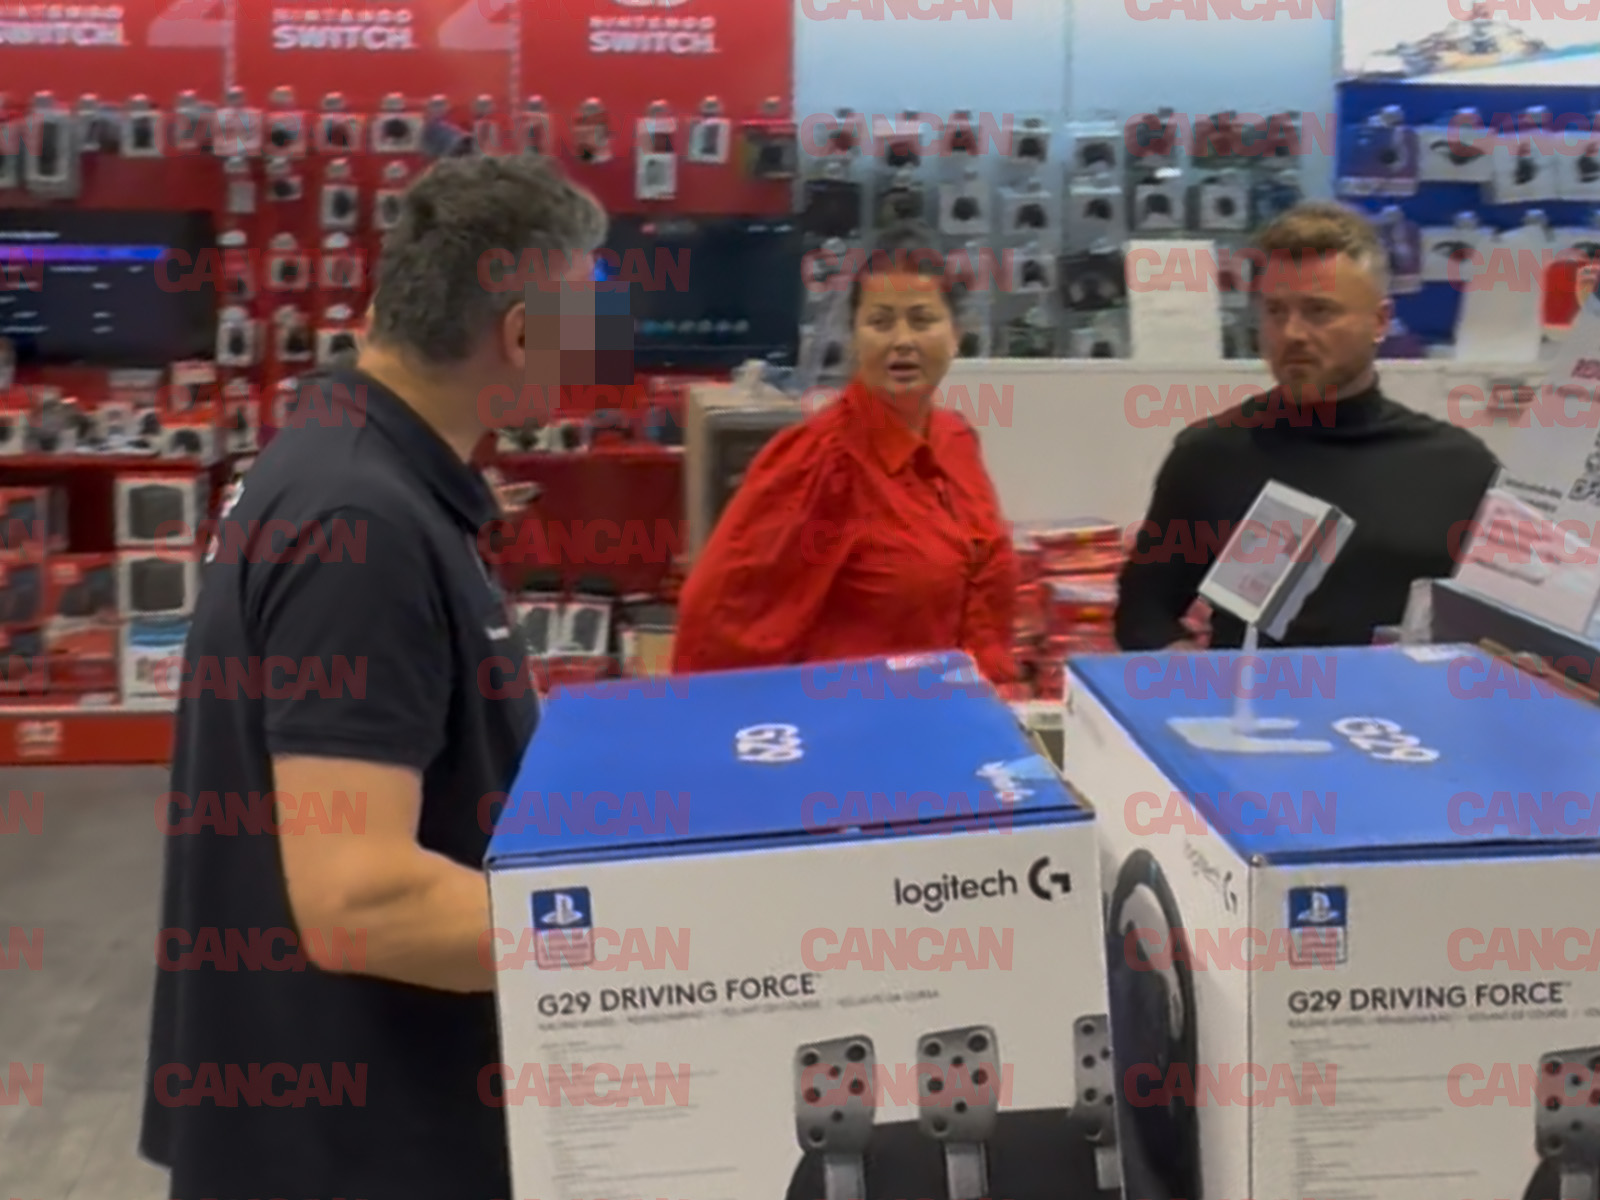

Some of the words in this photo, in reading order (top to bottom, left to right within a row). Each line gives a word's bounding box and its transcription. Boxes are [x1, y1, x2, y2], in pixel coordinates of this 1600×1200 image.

[272, 25, 414, 50] SWITCH
[588, 30, 716, 53] SWITCH
[894, 868, 1018, 913] logitech
[537, 991, 592, 1017] G29
[600, 981, 718, 1012] DRIVING
[726, 971, 817, 1001] FORCE
[1288, 989, 1342, 1014] G29
[1350, 985, 1467, 1011] DRIVING
[1475, 981, 1564, 1007] FORCE
